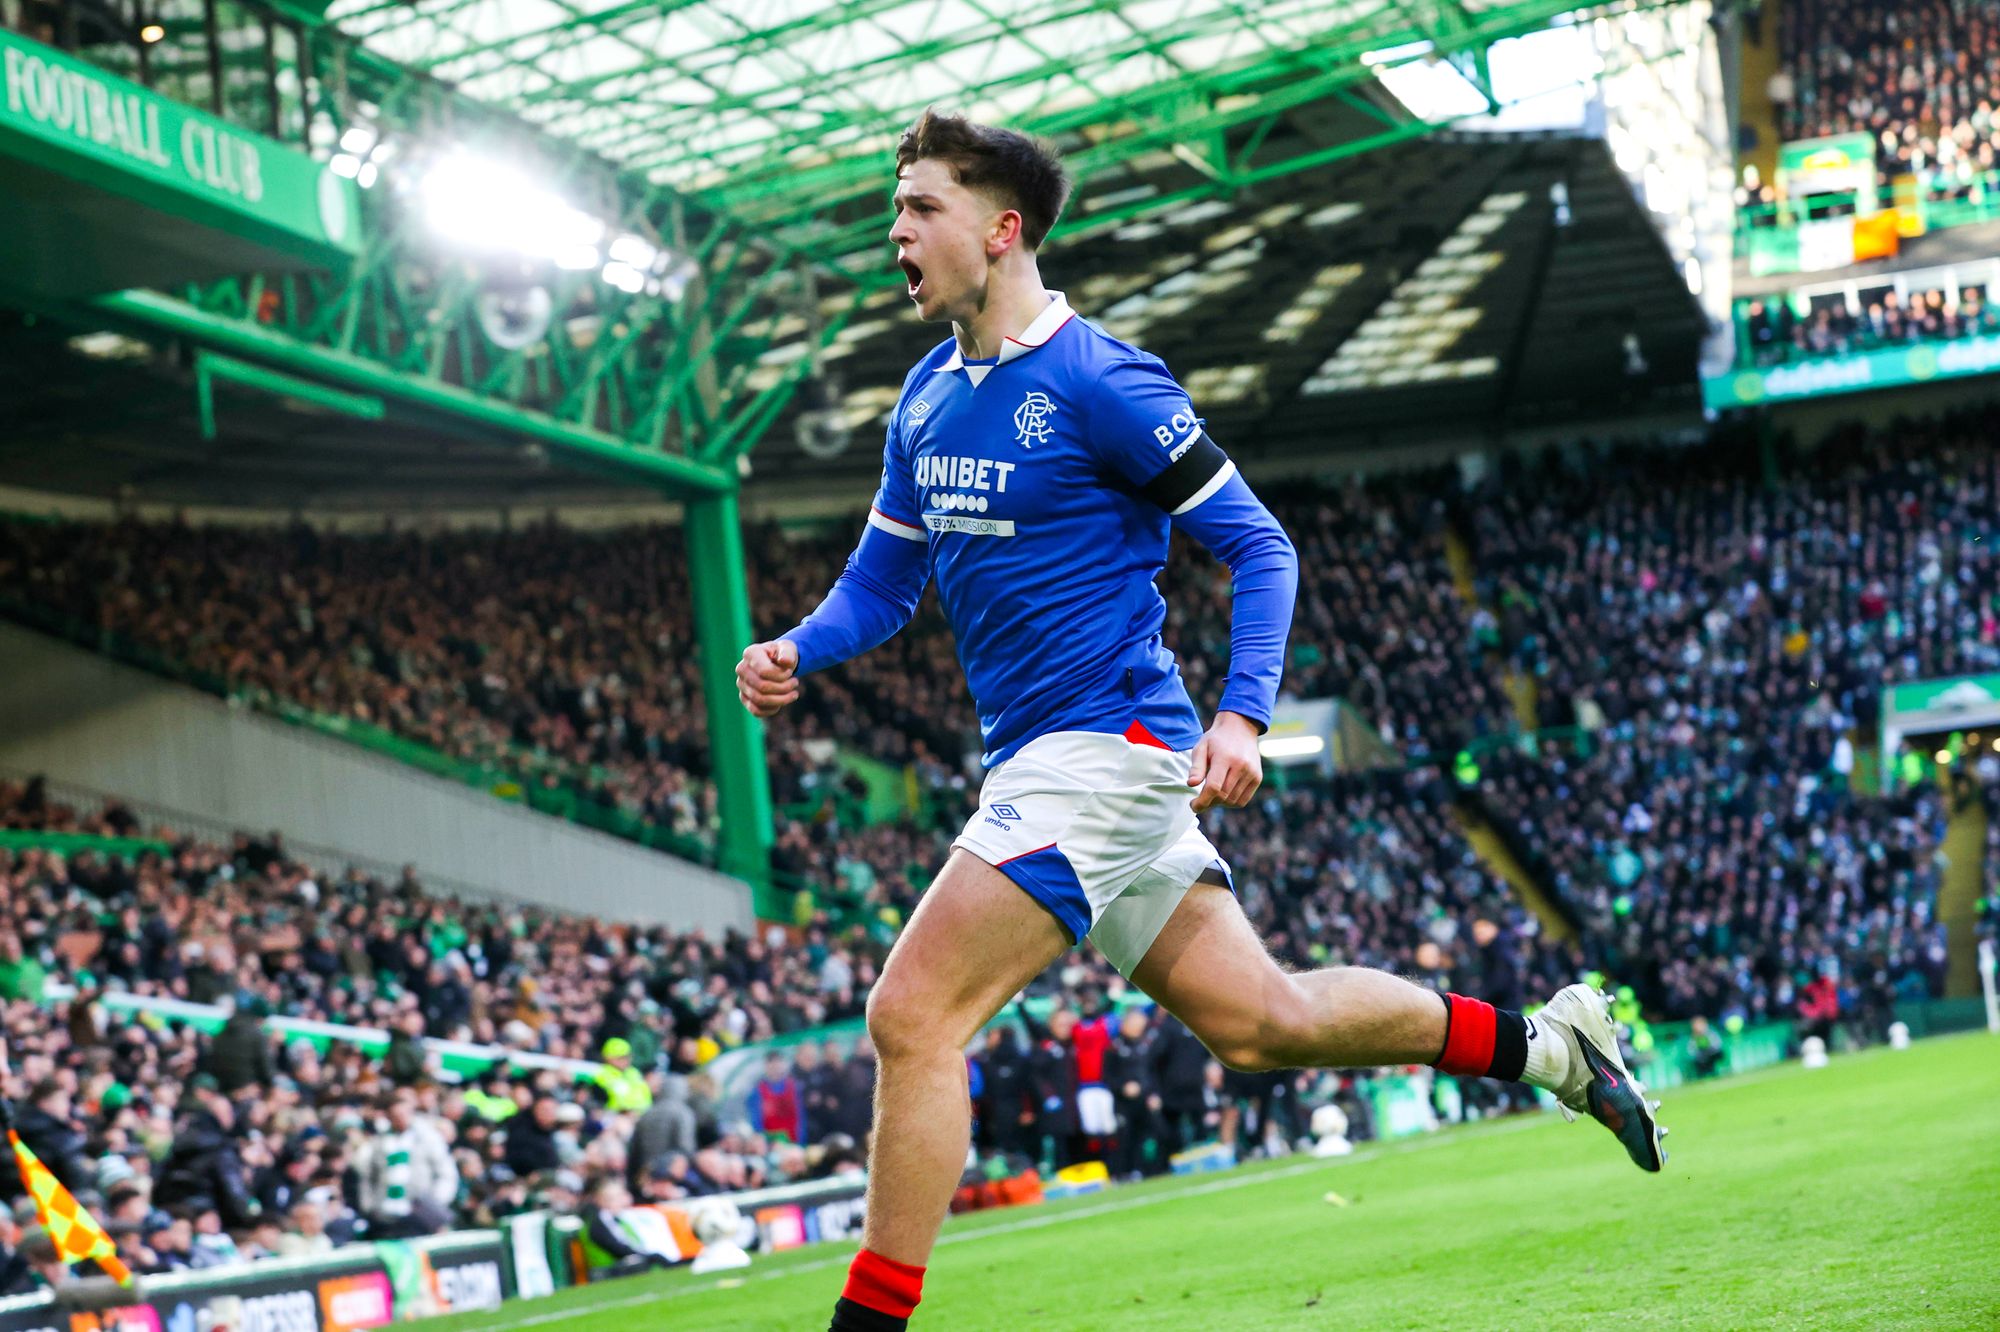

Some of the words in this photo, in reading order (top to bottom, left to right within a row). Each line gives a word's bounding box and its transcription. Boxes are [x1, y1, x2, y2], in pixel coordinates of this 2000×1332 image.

[4, 46, 171, 168] FOOTBALL
[180, 118, 263, 202] CLUB
[917, 456, 1015, 493] UNIBET
[957, 519, 997, 532] MISSION
[984, 816, 1011, 832] umbro
